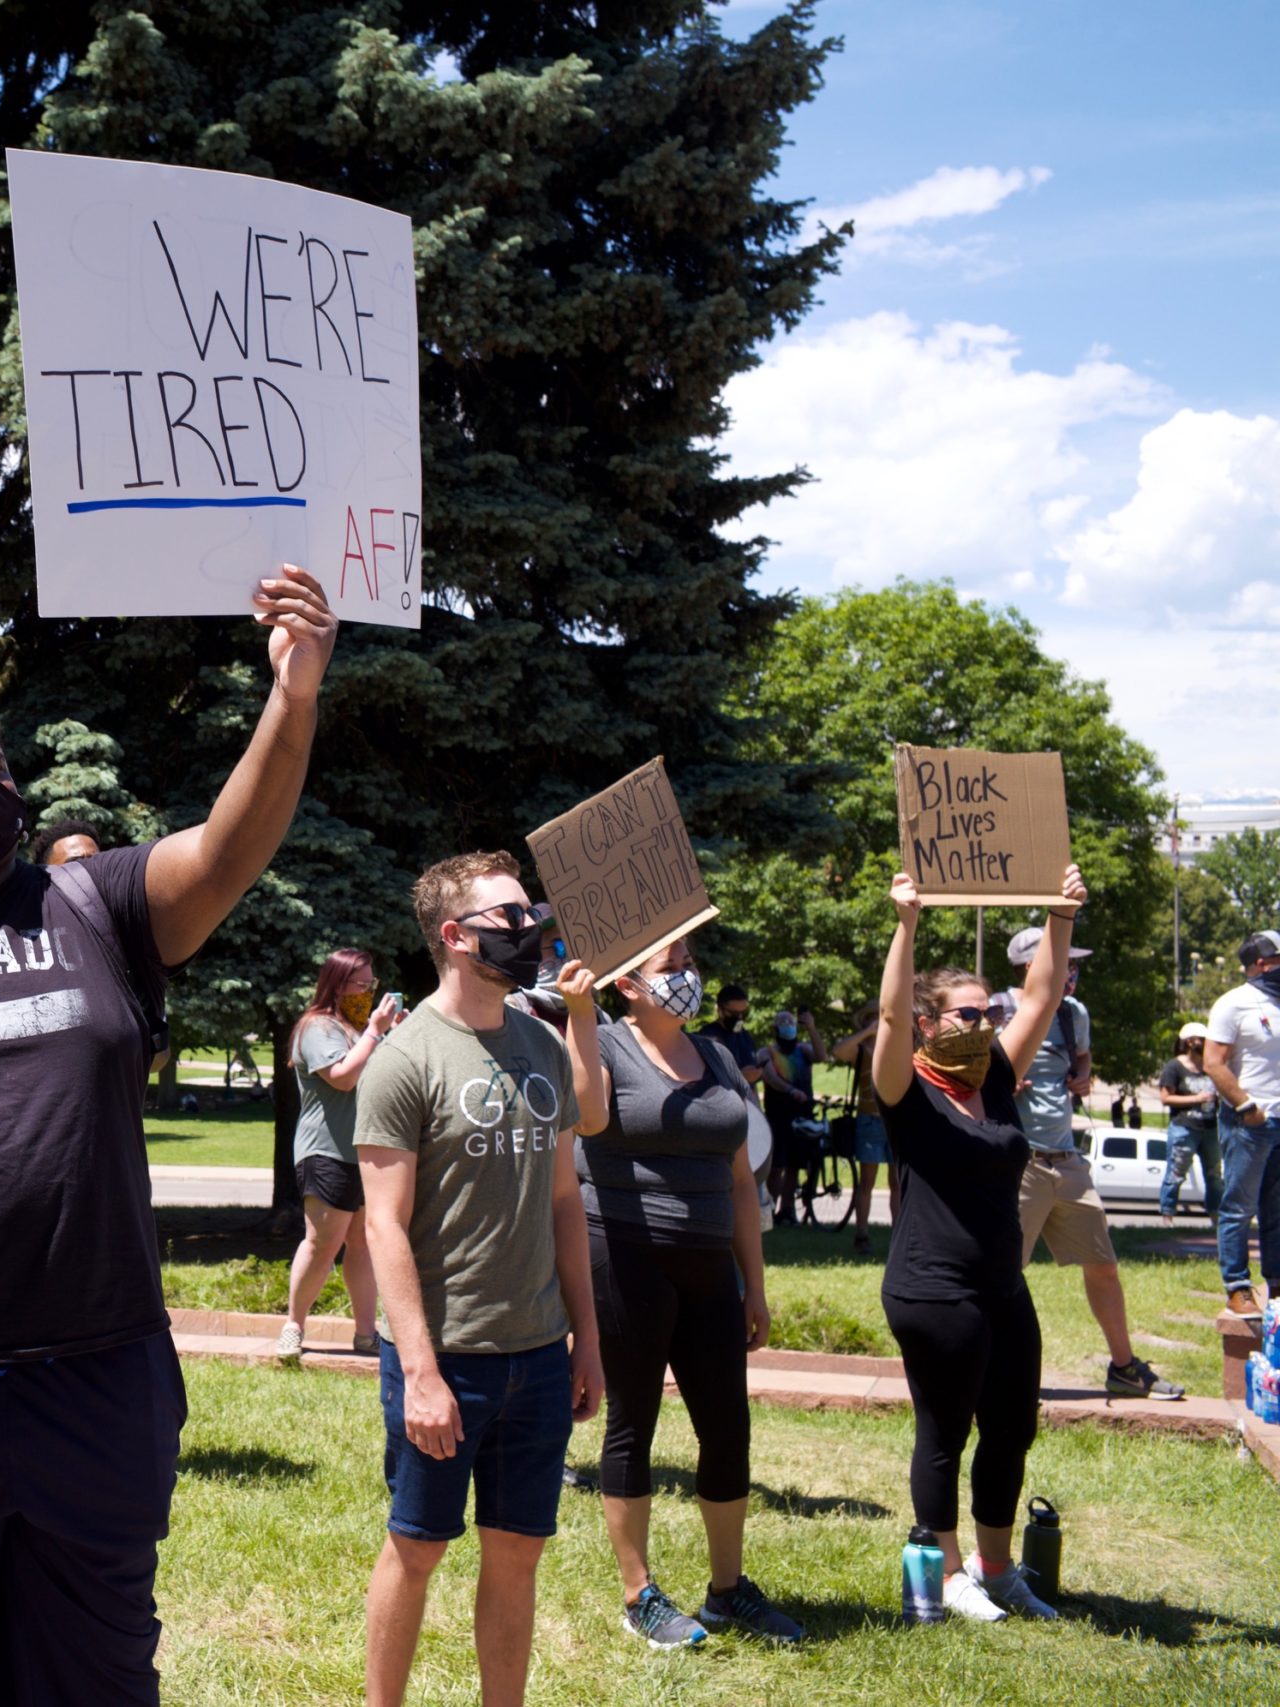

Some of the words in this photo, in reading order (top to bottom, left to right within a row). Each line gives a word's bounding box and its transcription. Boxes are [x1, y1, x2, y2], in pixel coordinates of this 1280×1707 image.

[153, 219, 391, 385] WE'RE
[40, 370, 307, 493] TIRED
[916, 760, 1009, 811] Black
[535, 826, 581, 897] I
[579, 767, 668, 866] CAN'T
[936, 806, 996, 841] Lives
[913, 837, 1015, 885] Matter
[459, 1072, 559, 1128] GO
[464, 1126, 560, 1157] GREEN
